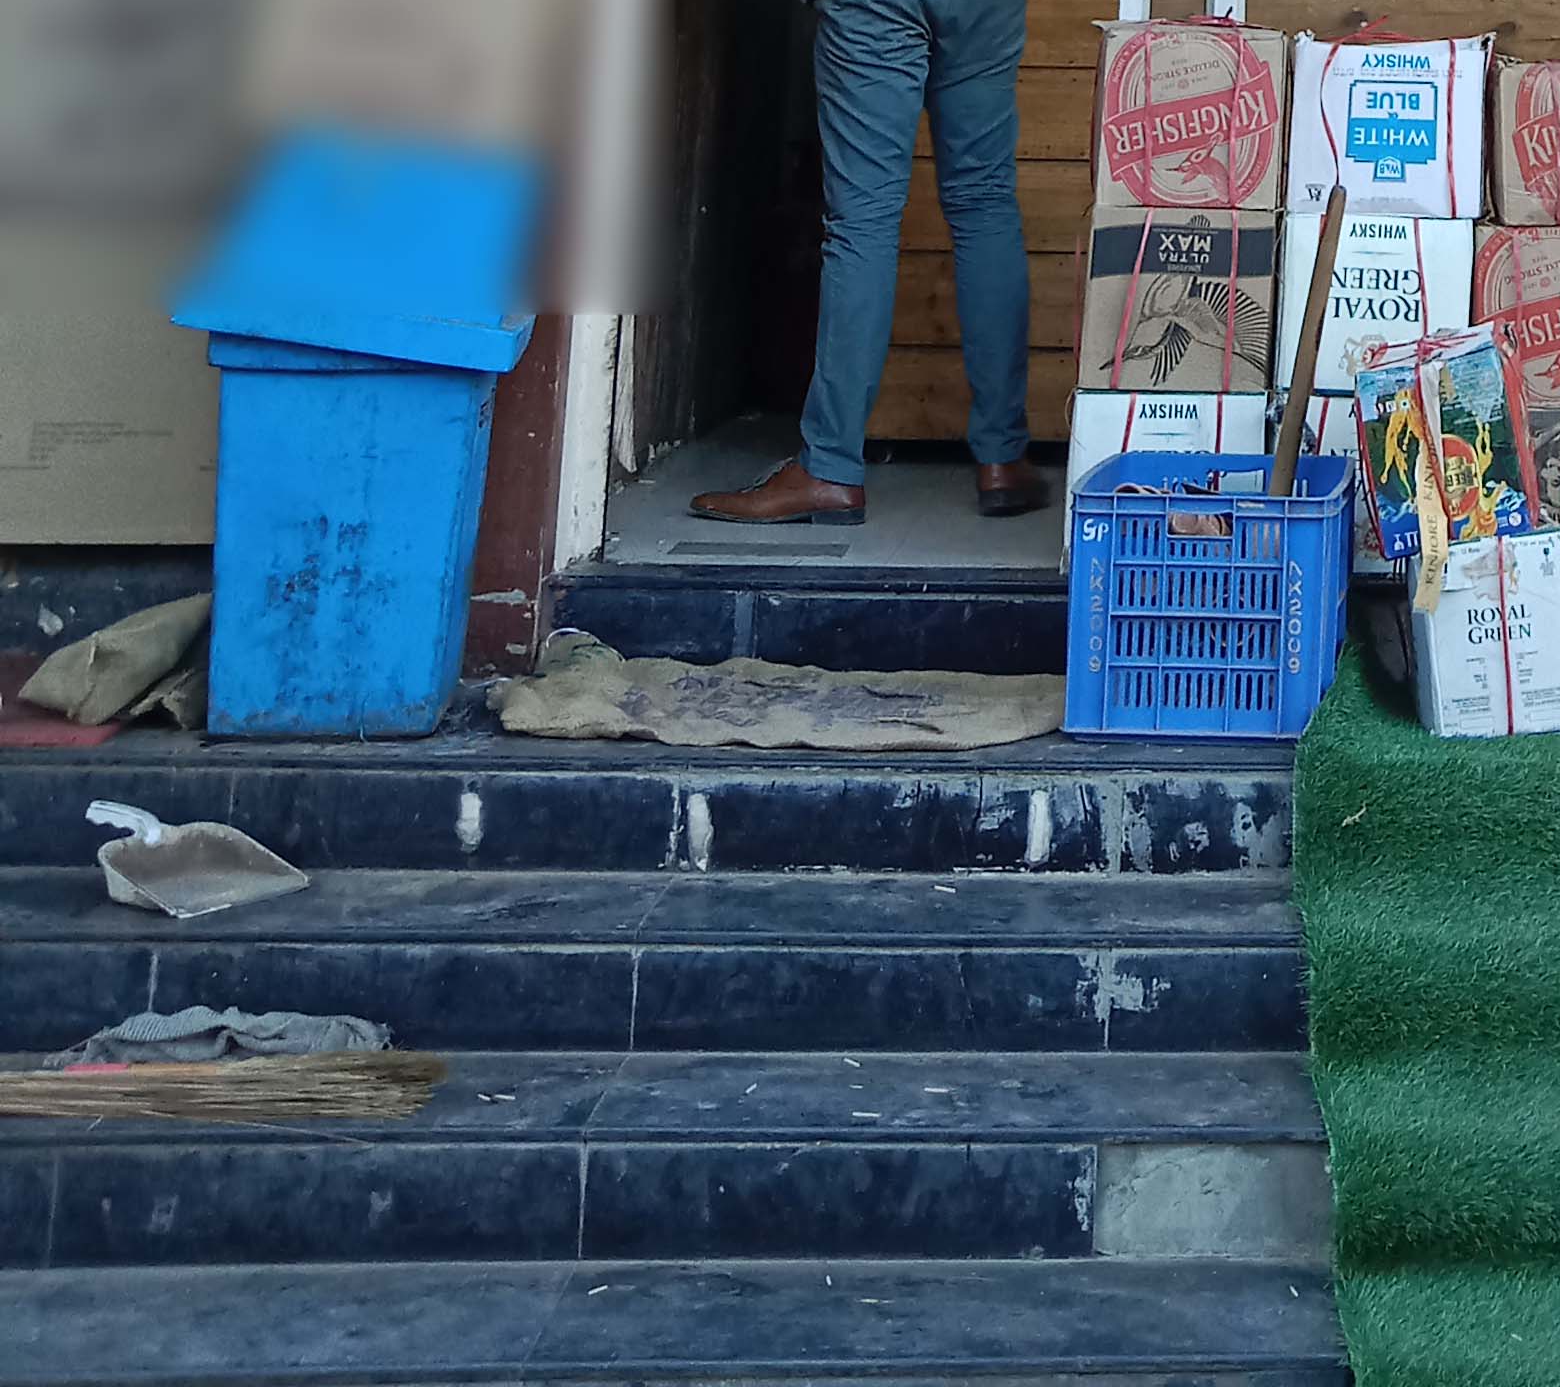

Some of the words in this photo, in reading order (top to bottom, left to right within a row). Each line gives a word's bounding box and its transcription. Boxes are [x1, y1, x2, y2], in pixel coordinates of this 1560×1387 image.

[1361, 53, 1431, 69] WHISKY
[1365, 90, 1421, 111] BLUE
[1348, 222, 1407, 240] WHISKY
[1158, 233, 1212, 252] MAX
[1157, 250, 1210, 264] ULTRA
[1330, 267, 1422, 295] GREEN
[1330, 296, 1421, 323] ROYAL
[1138, 403, 1198, 420] WHISKY
